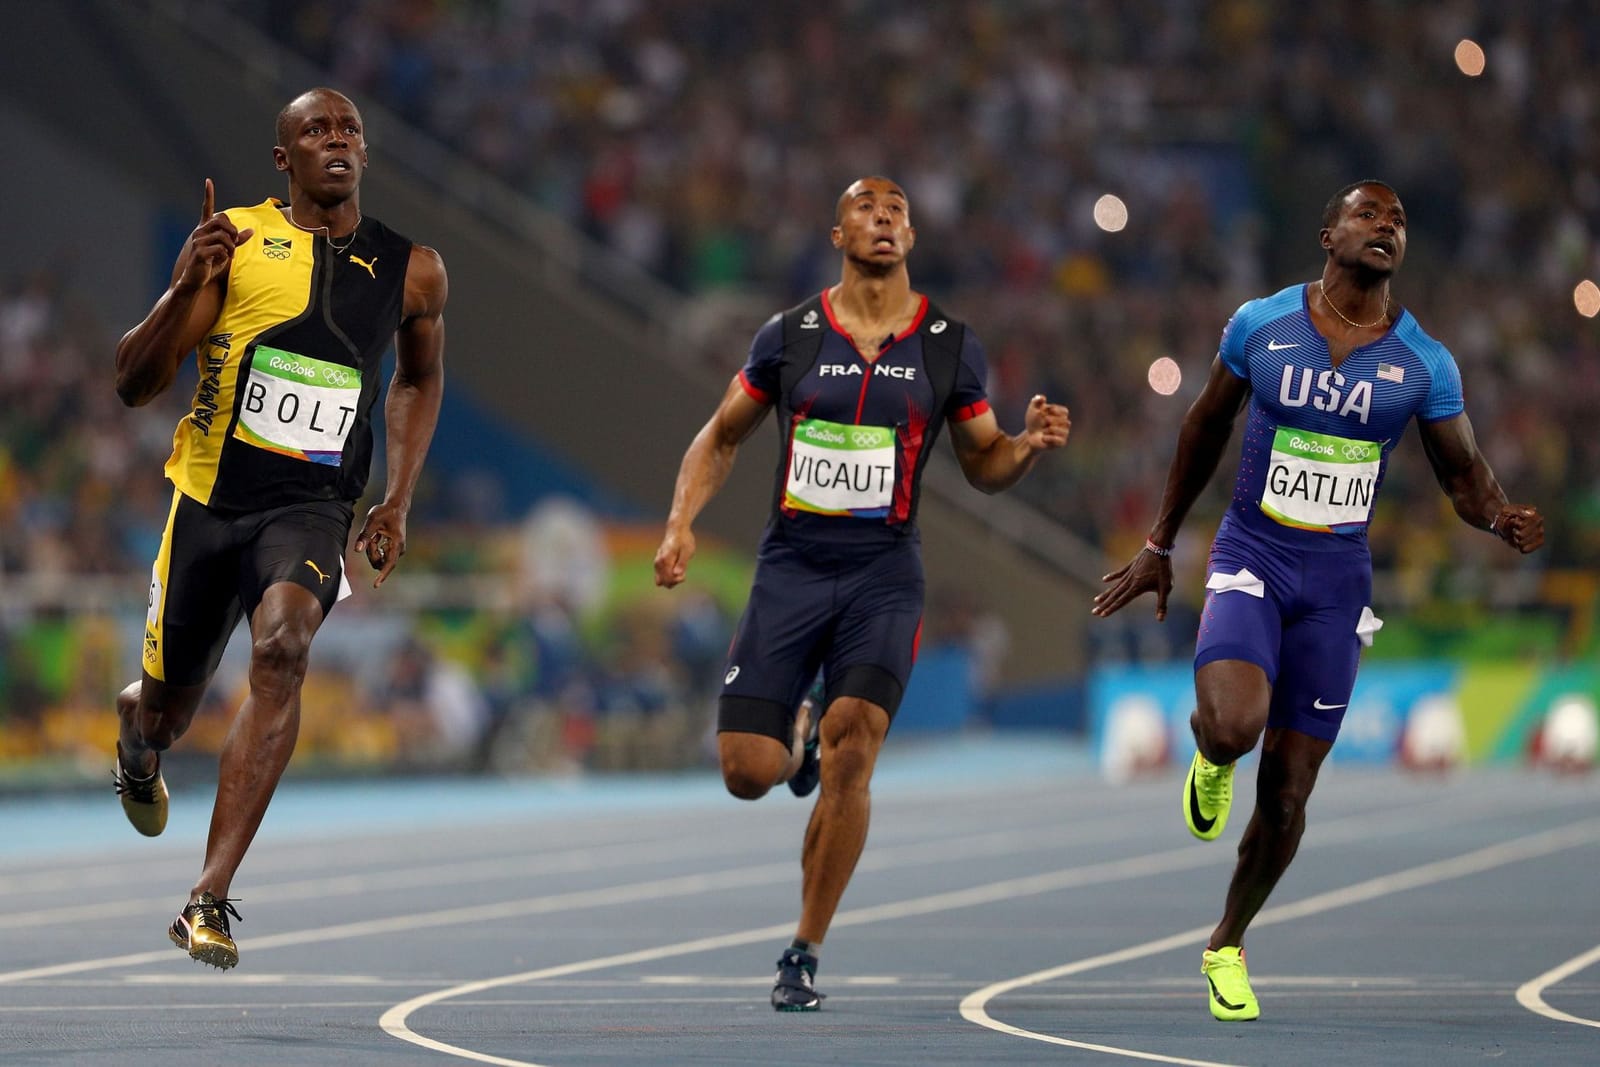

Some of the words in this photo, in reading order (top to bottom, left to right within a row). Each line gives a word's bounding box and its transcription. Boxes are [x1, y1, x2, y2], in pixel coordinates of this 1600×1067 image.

[245, 381, 355, 436] BOLT
[1279, 364, 1374, 425] USA
[793, 453, 892, 493] VICAUT
[1270, 465, 1372, 507] GATLIN
